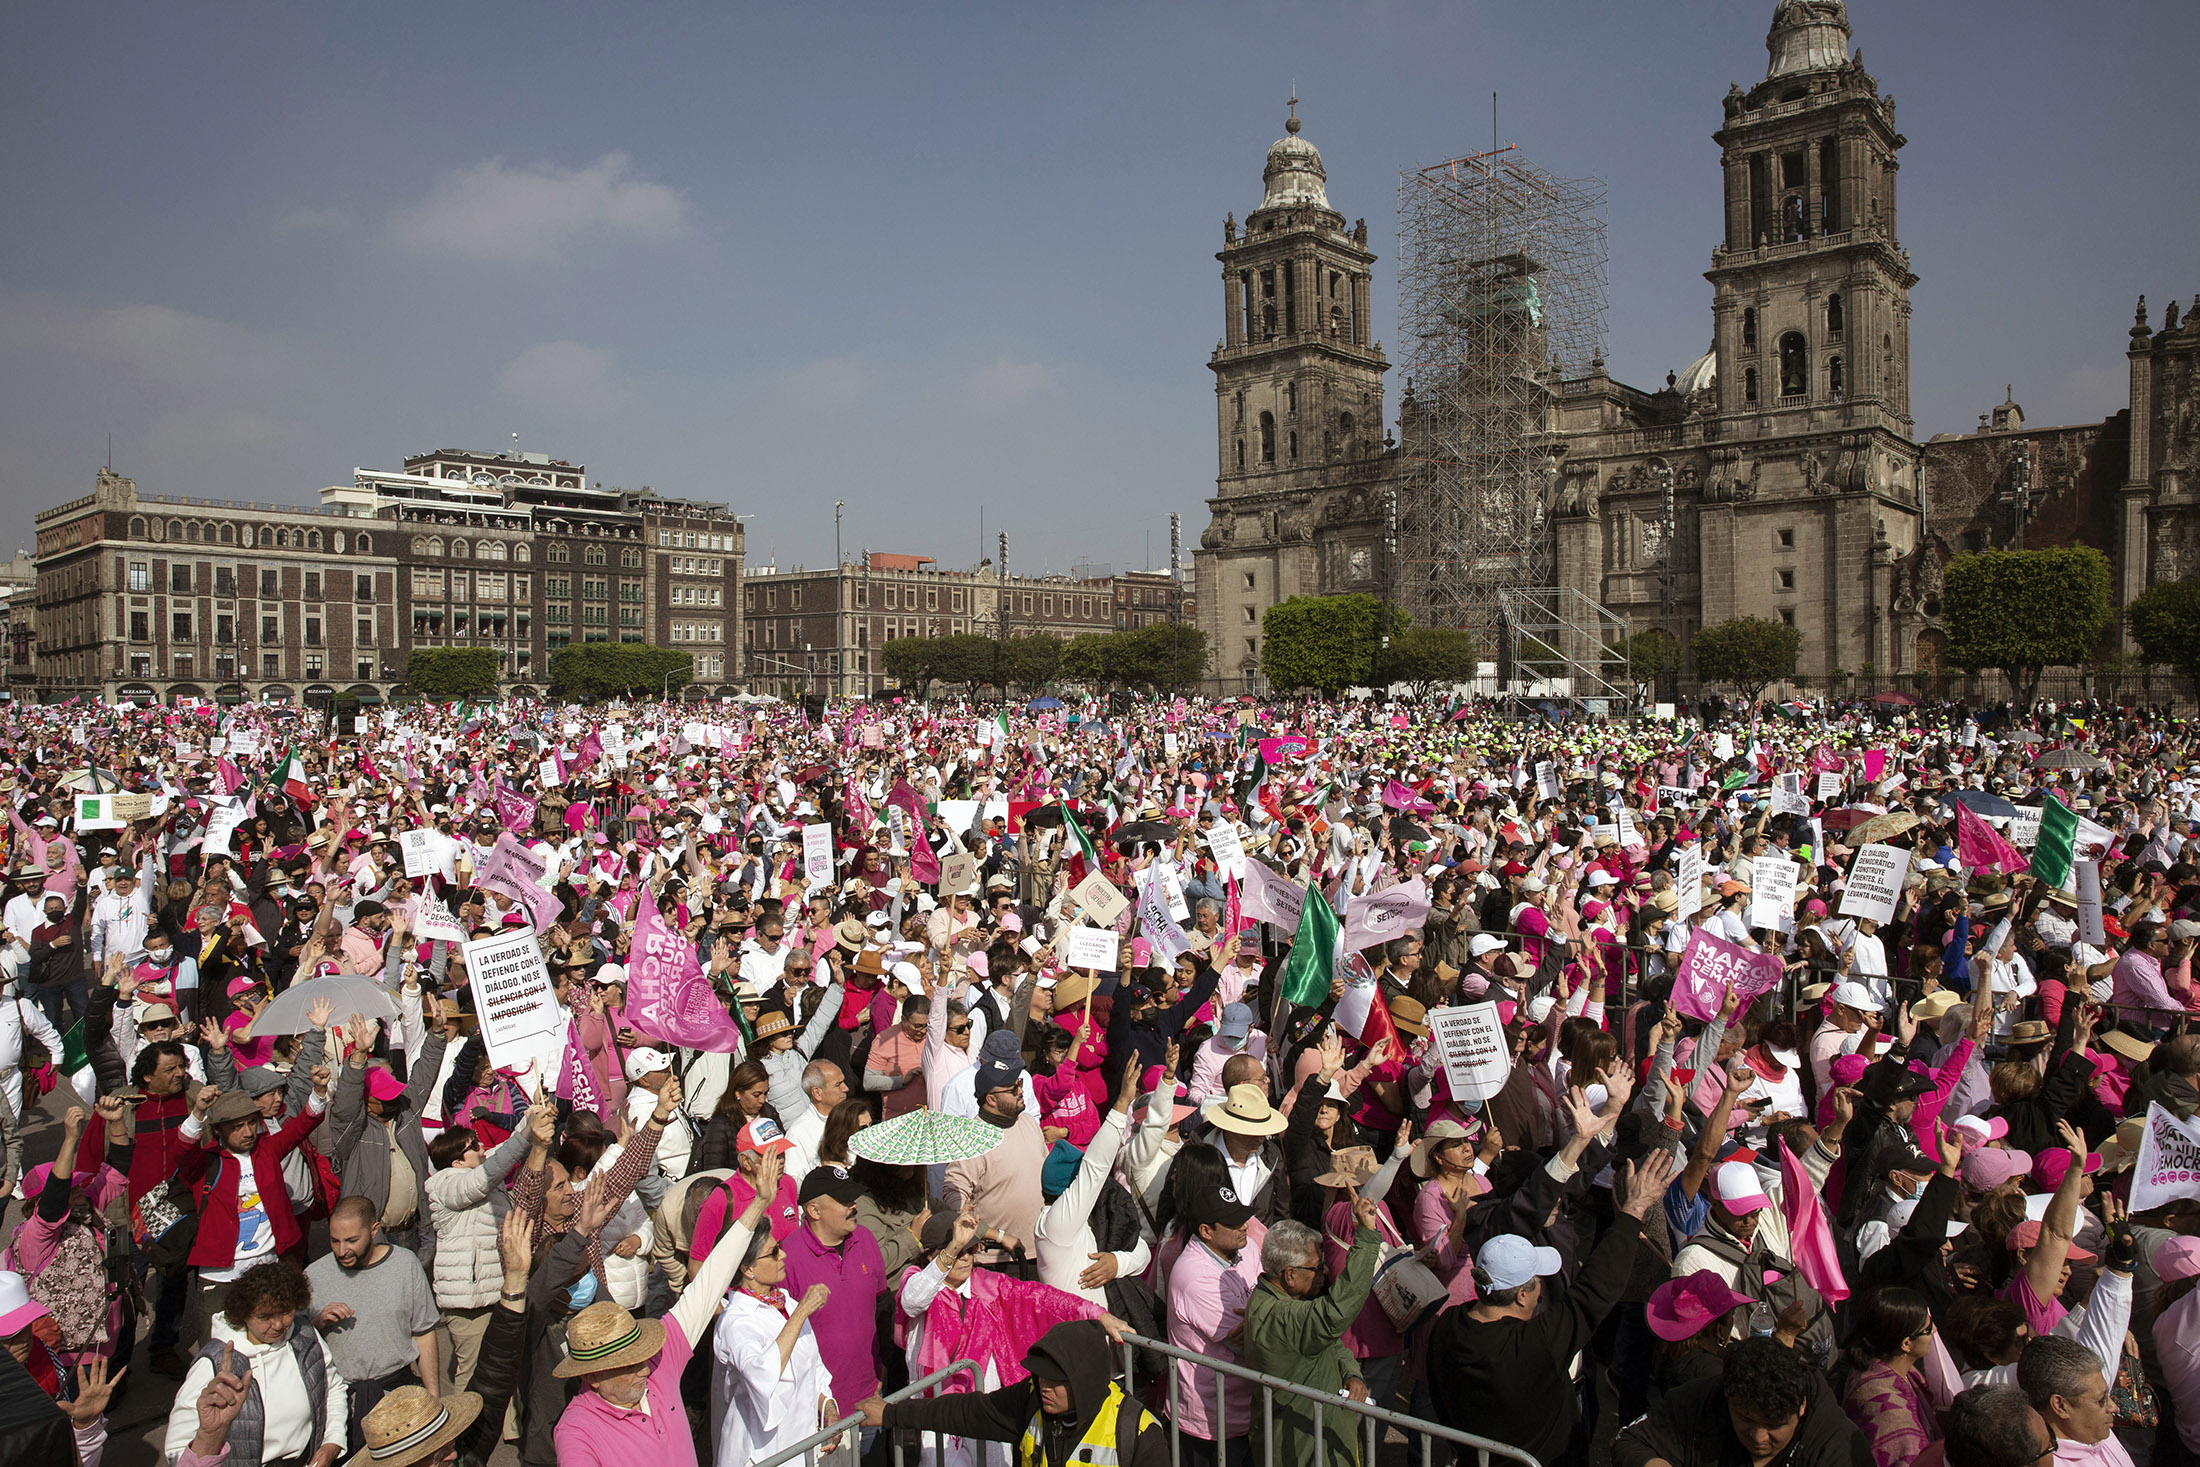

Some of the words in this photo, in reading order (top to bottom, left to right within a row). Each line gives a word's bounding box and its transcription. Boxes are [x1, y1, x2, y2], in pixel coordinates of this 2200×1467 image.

[1868, 849, 1890, 859] DIÁLOGO
[1856, 866, 1886, 876] CONSTRUYE
[1859, 858, 1896, 870] DEMOCRÁTICO
[1850, 882, 1894, 897] AUTORITARISMO
[1847, 890, 1870, 900] LEVANTA
[1870, 894, 1893, 906] MUROS.
[479, 956, 490, 966] LA
[490, 947, 521, 963] VERDAD
[522, 945, 530, 954] SE
[1694, 951, 1725, 974] POR
[1698, 940, 1778, 980] MARCHA
[482, 962, 520, 980] DEFIENDE
[521, 959, 535, 970] CON
[534, 956, 541, 965] EL
[522, 973, 533, 984] NO
[533, 970, 541, 980] SE
[488, 990, 523, 1008] SILENCIA
[524, 985, 539, 997] CON
[539, 982, 547, 993] LA
[1450, 1018, 1472, 1027] VERDAD
[1473, 1016, 1481, 1024] SE
[1443, 1029, 1471, 1039] DEFIENDE
[1472, 1027, 1485, 1035] CON
[1473, 1038, 1482, 1046] NO
[1483, 1036, 1491, 1044] SE
